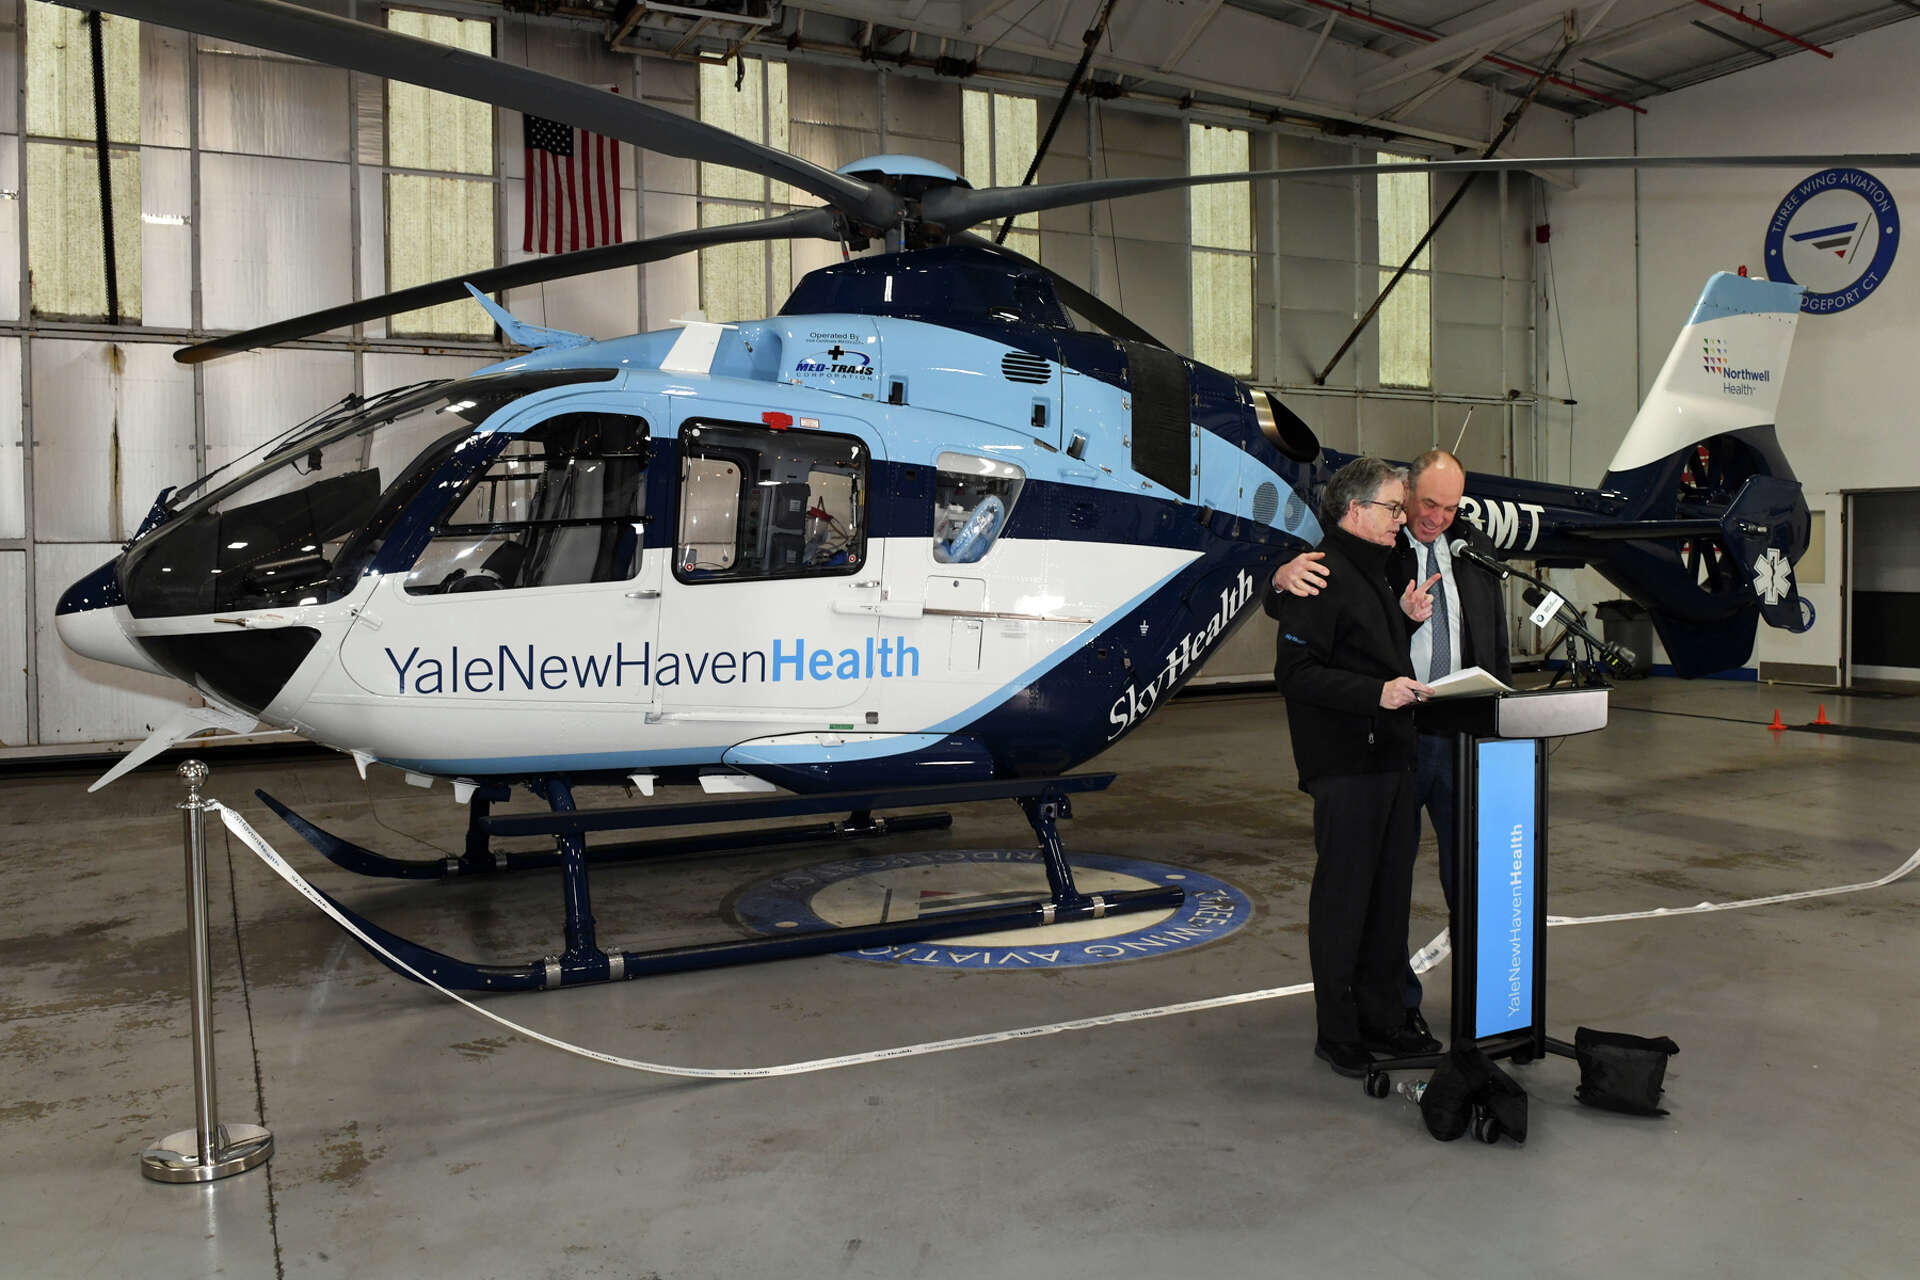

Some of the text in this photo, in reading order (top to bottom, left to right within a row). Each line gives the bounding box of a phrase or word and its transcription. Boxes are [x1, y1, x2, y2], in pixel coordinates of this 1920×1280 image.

[1772, 173, 1891, 233] THREE WING AVIATION
[1801, 271, 1879, 311] DGEPORT CT
[809, 332, 861, 341] Operated By
[796, 372, 873, 381] CORPORATION
[1723, 367, 1770, 382] Northwell
[1723, 382, 1753, 396] Health
[383, 636, 921, 695] YaleNewHavenHealth
[1107, 568, 1254, 741] SkyHealth
[1508, 823, 1523, 1018] YaleNewHavenHealth
[857, 945, 1061, 965] AVIATIO
[1084, 927, 1214, 958] WING
